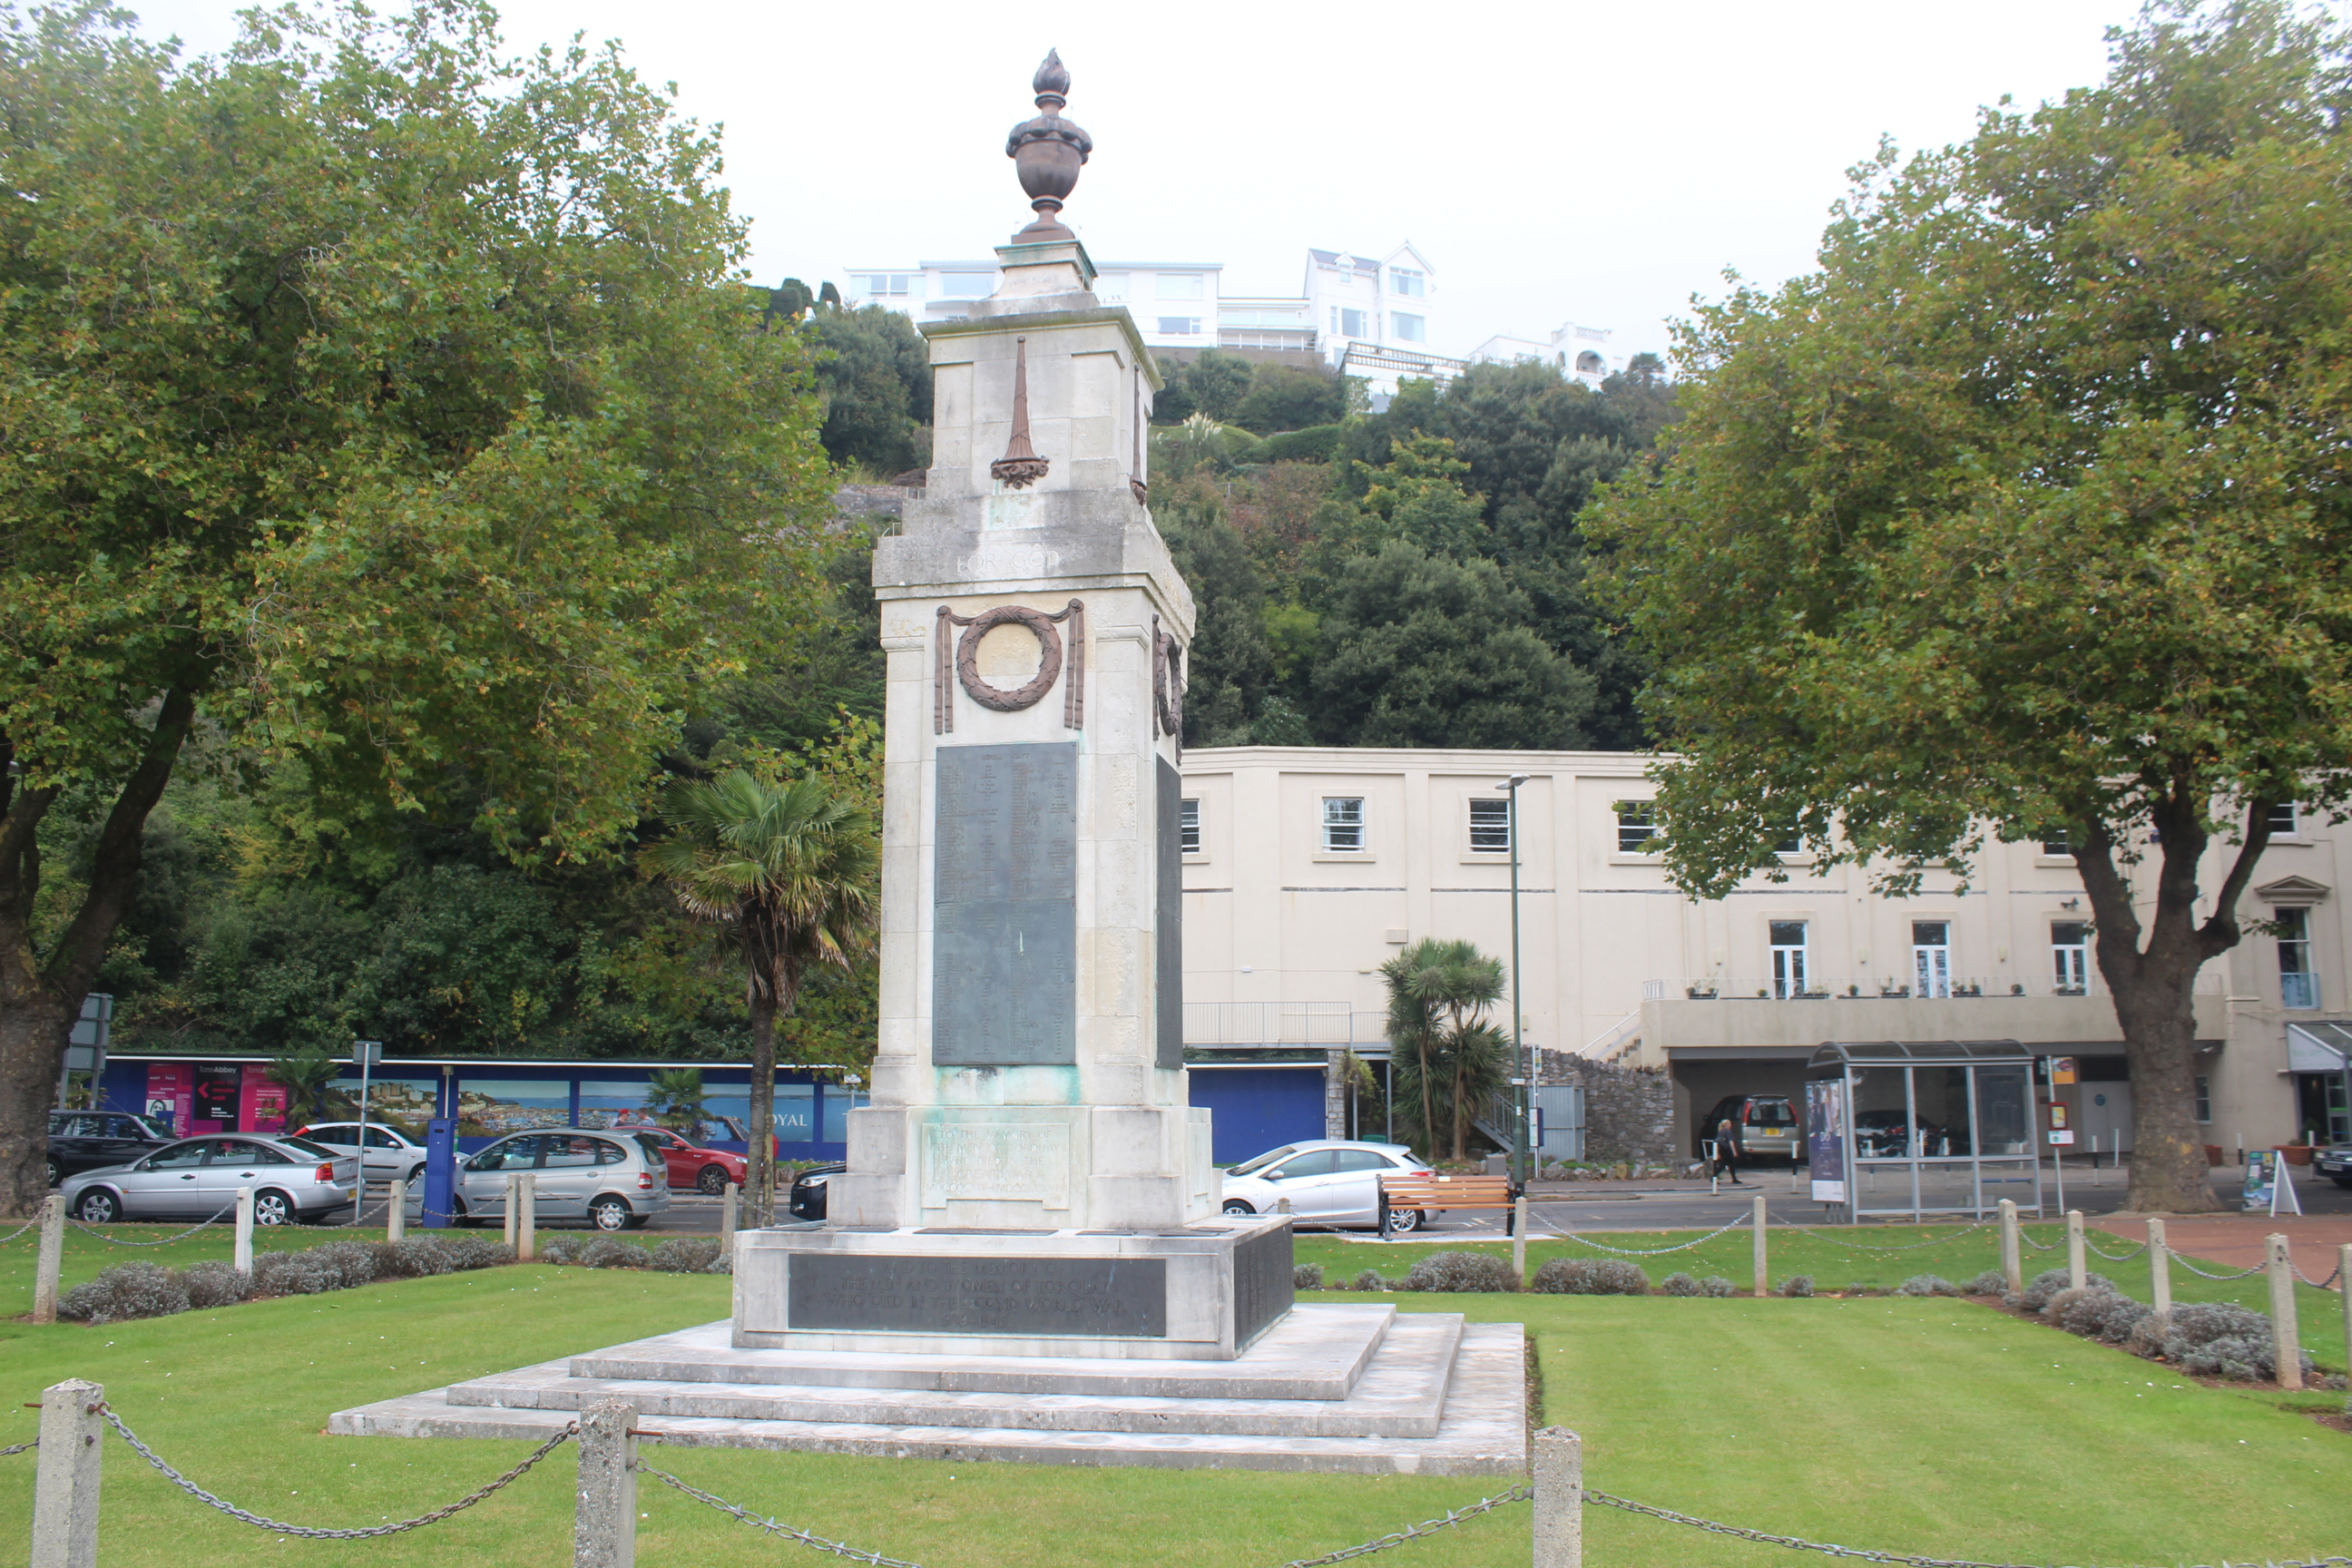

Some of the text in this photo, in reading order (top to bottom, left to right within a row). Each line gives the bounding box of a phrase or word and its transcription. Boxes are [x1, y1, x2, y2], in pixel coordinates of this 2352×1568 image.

[938, 1130, 1052, 1140] TO THE MEMORY OF
[957, 1142, 981, 1152] MEN
[988, 1142, 1002, 1152] OF
[1008, 1142, 1060, 1153] TORQUAY
[945, 1156, 1044, 1166] WHO DIED IN THE
[957, 1169, 1033, 1180] GREAT WAR
[883, 1260, 1065, 1276] AND TO THE MEMORY OF
[840, 1277, 866, 1289] THE
[906, 1278, 939, 1292] AND
[943, 1279, 1004, 1293] WOMEN
[1011, 1279, 1031, 1293] OF
[1035, 1280, 1109, 1298] TORQUAY
[826, 1292, 1127, 1313] WHO DIED IN THE SECOND WORLD WAR
